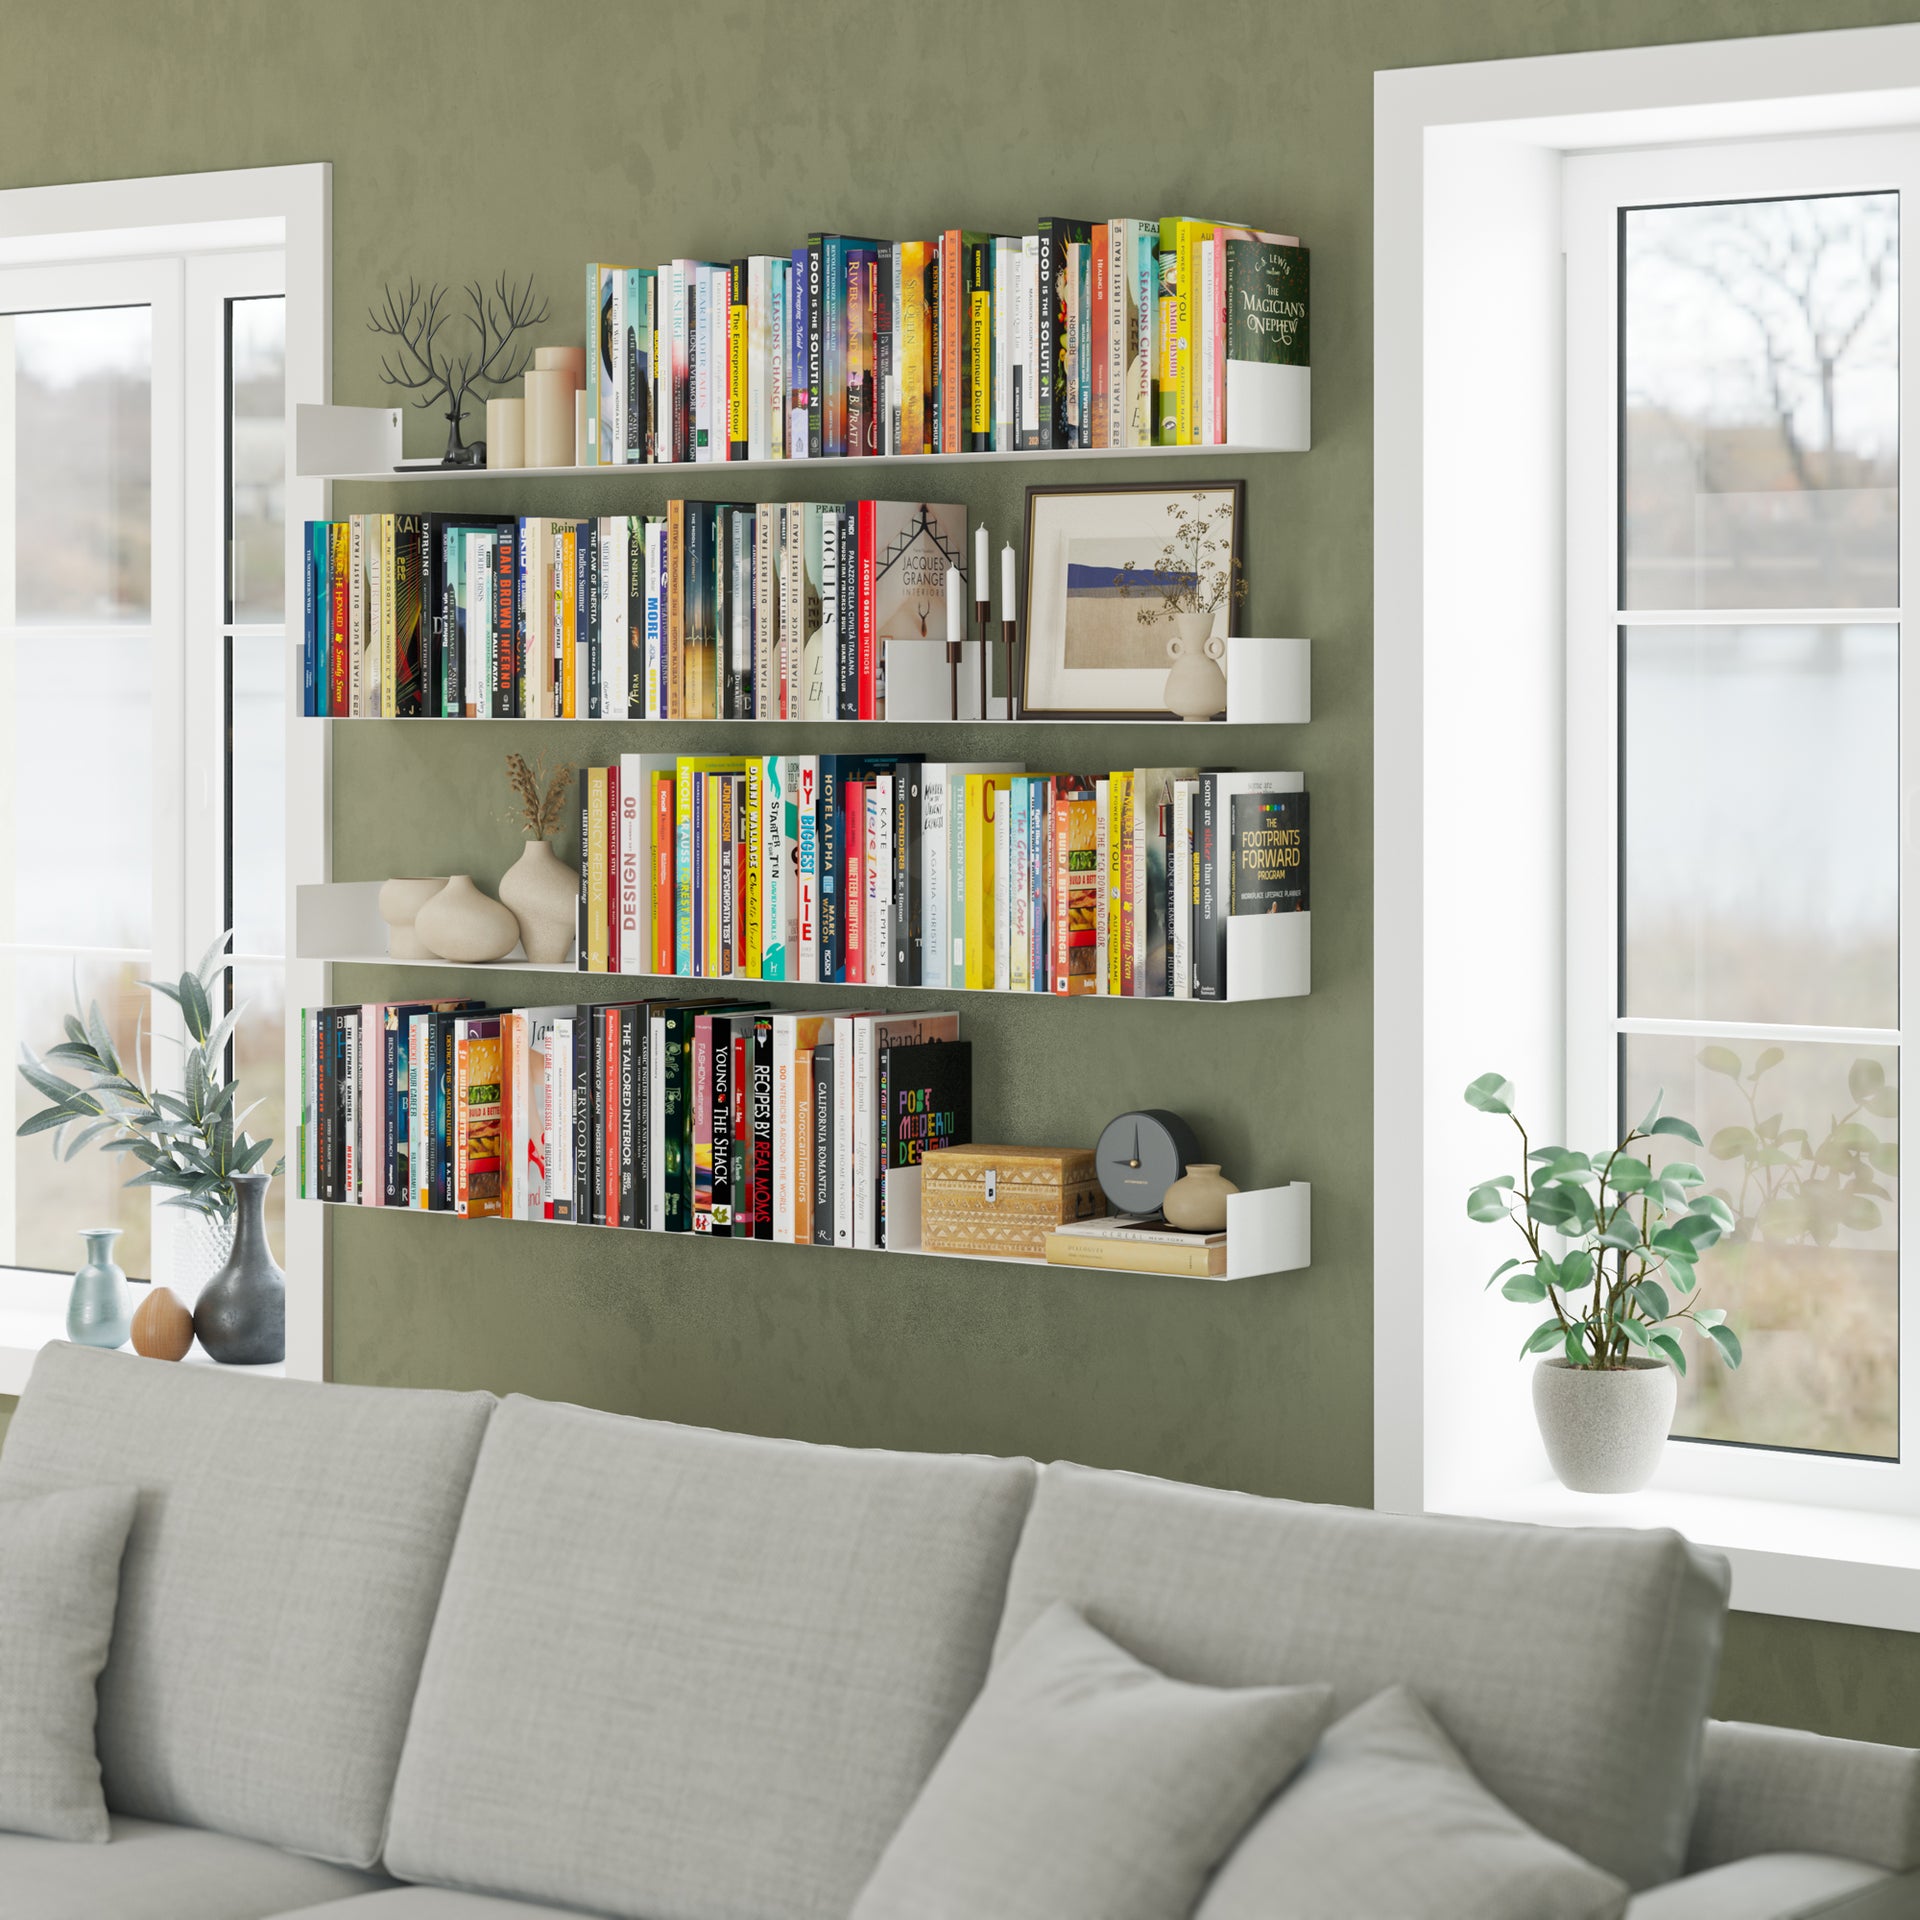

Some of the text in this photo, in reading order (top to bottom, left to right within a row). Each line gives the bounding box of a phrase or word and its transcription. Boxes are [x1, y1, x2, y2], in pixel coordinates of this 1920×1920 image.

[811, 253, 819, 294] FOOD
[1041, 238, 1049, 281] FOOD
[1269, 254, 1292, 275] LEWIS
[811, 299, 818, 307] IS
[1042, 286, 1048, 294] IS
[1241, 290, 1305, 317] MAGICIAN'S
[1266, 284, 1279, 296] THE
[1140, 272, 1149, 397] SEASONS CHANGE
[1247, 313, 1298, 345] NEPHEW
[732, 333, 740, 397] Entrepreneur
[772, 293, 781, 411] SEASONS CHANGE
[974, 320, 982, 387] Entrepreneur
[850, 409, 859, 446] PRATT
[590, 574, 596, 585] OF
[823, 530, 836, 624] OCULUS
[903, 556, 944, 570] JACQUES
[903, 571, 944, 586] GRANGE
[903, 588, 944, 597] INTERIORS
[500, 546, 511, 689] DAN BROWN INFERNO
[648, 598, 658, 639] MORE
[723, 783, 731, 841] JON RONSON
[749, 766, 758, 868] DANNY WALLACE
[868, 799, 877, 849] Here
[1266, 818, 1277, 828] THE
[593, 780, 602, 901] REGENCY REDUX
[681, 766, 689, 950] NICOLE KRAUSS FOREST DARK
[801, 770, 814, 941] MY BIGGEST LIE
[1058, 832, 1066, 863] BUILD
[1205, 829, 1213, 860] sicker
[1242, 830, 1300, 848] FOOTPRINTS
[1242, 848, 1301, 869] FORWARD
[624, 797, 636, 930] DESIGN 80
[849, 857, 858, 897] NINETEEN
[869, 869, 877, 898] Am
[1017, 810, 1026, 935] The Gelatin Coast
[1205, 864, 1213, 885] than
[1257, 870, 1285, 880] PROGRAM
[723, 850, 731, 944] THE PSYCHOPATH TEST
[749, 873, 758, 949] Charlotte Street
[1058, 879, 1066, 916] BETTER
[1205, 888, 1213, 919] others
[849, 900, 858, 949] EIGHTY-FOUR
[1058, 921, 1066, 963] BURGER
[596, 1080, 601, 1089] OF
[623, 1023, 631, 1165] THE TAILORED INTERIOR
[900, 1088, 932, 1114] POST
[578, 1072, 586, 1184] VERVOORDT
[714, 1047, 728, 1185] YOUNG THE SHACK
[900, 1112, 954, 1139] MODERN
[755, 1065, 770, 1222] RECIPES BY REAL MOMS
[818, 1083, 826, 1204] CALIFORNIA ROMANTICA
